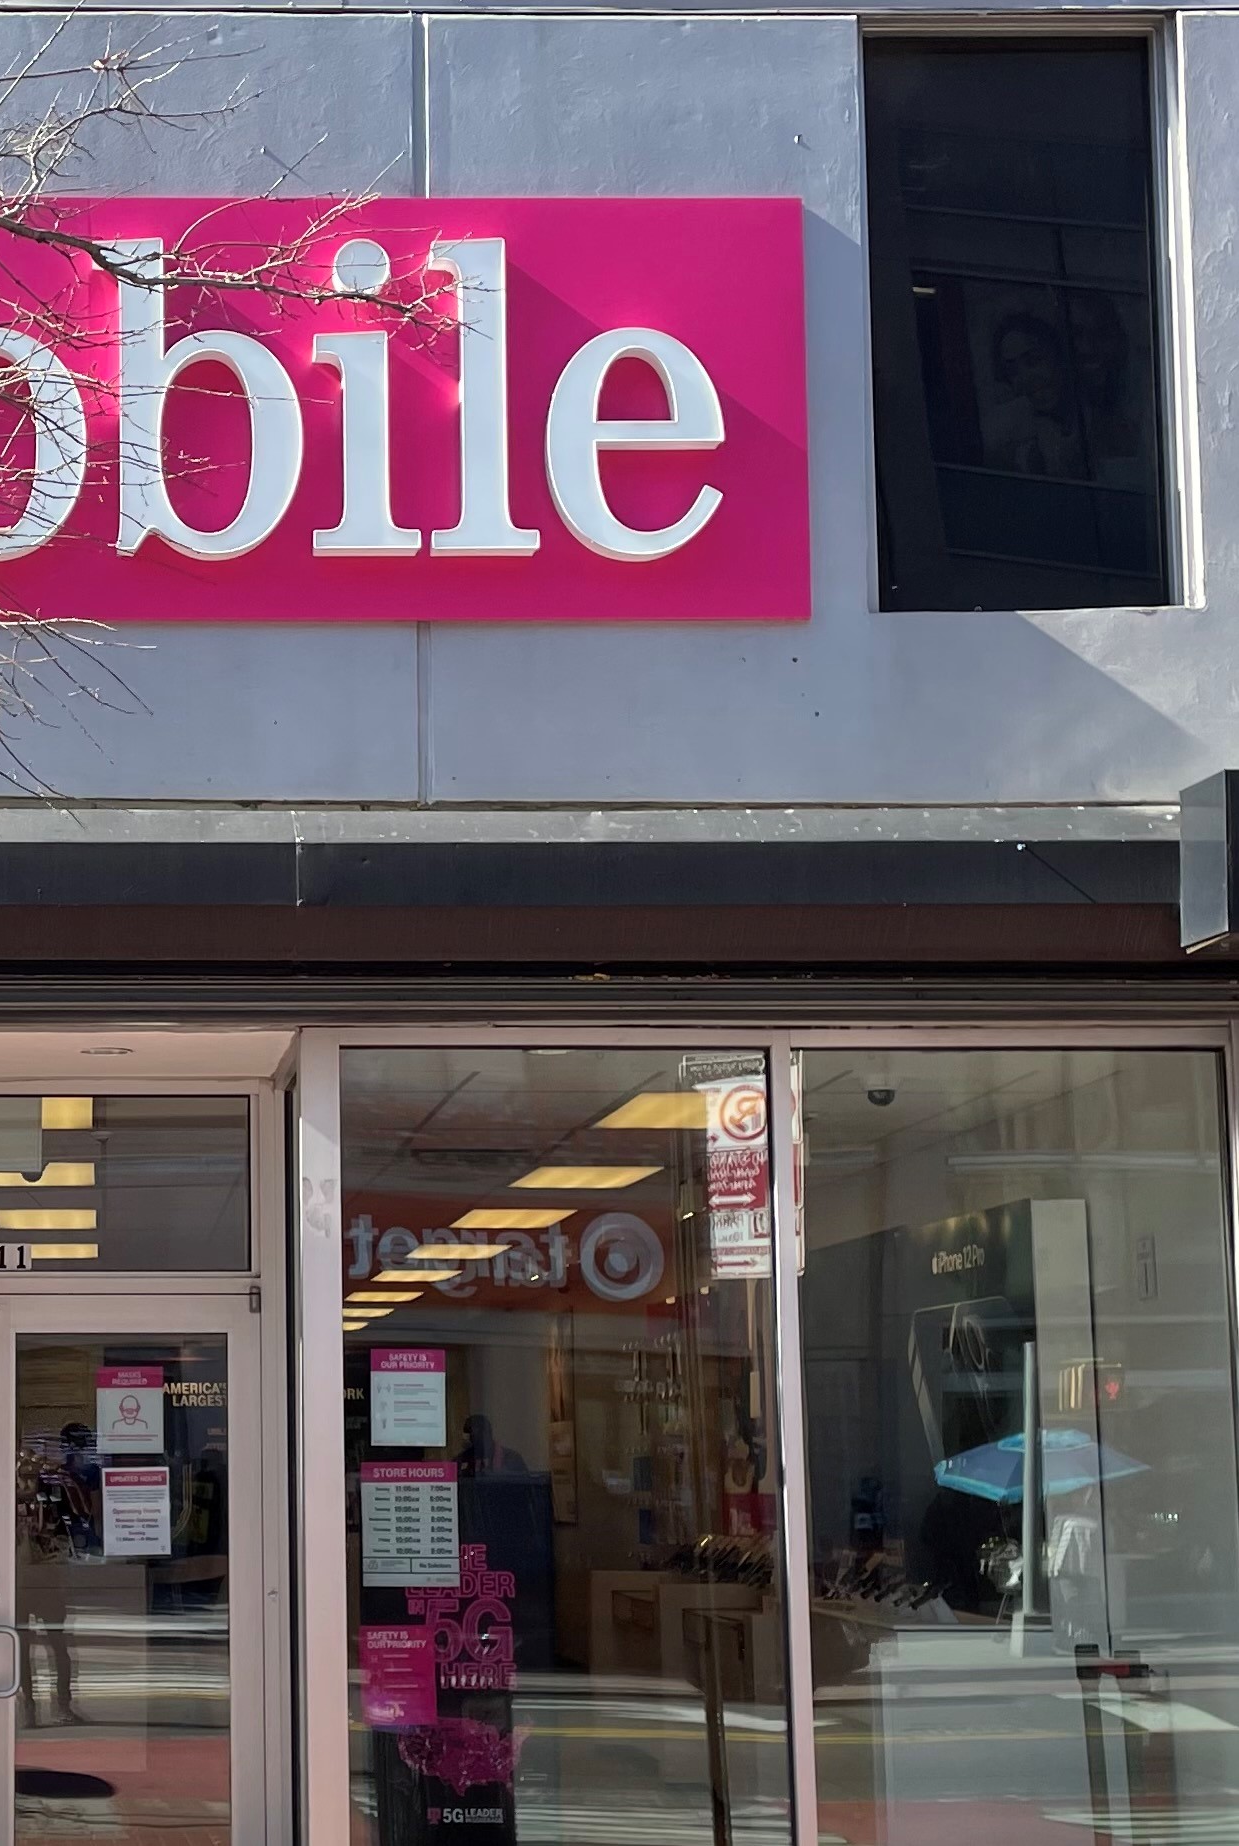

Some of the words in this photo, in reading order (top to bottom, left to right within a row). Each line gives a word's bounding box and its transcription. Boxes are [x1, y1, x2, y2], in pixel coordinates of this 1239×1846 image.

[399, 1361, 435, 1369] PRIORITY
[373, 1468, 407, 1478] STORE
[409, 1468, 445, 1478] HOURS
[443, 1808, 464, 1823] 5G
[465, 1808, 504, 1818] LEADER
